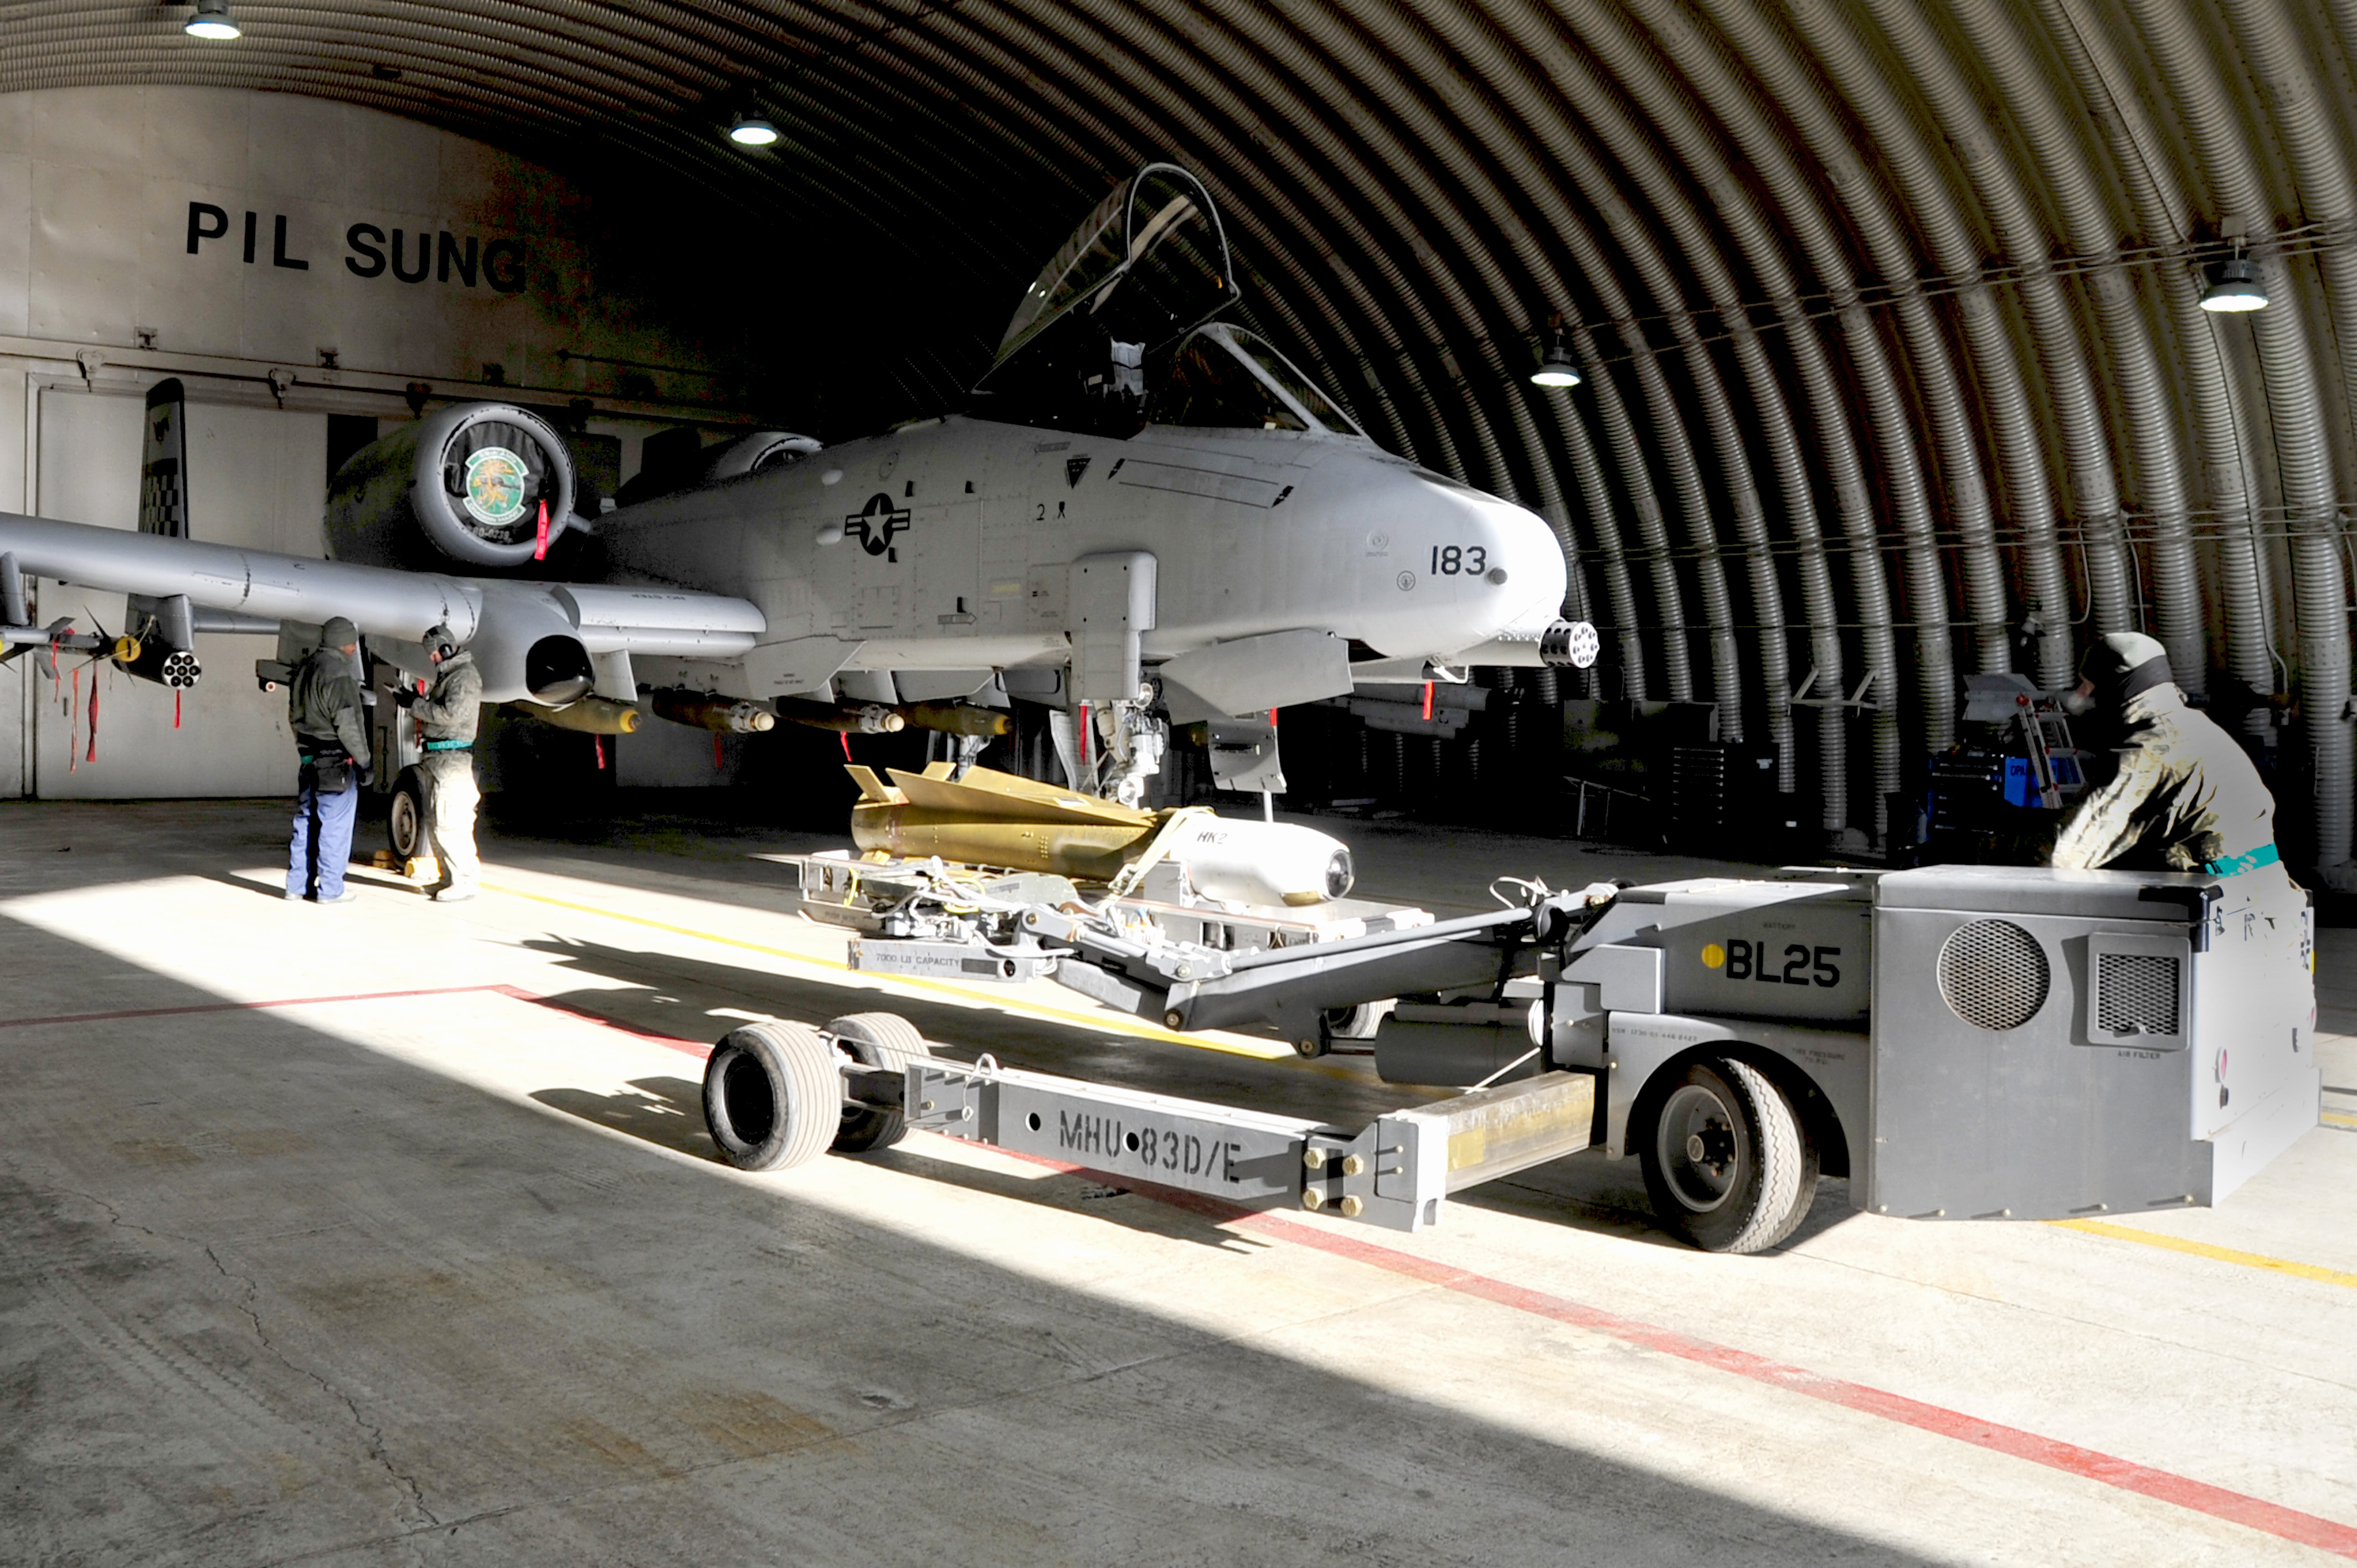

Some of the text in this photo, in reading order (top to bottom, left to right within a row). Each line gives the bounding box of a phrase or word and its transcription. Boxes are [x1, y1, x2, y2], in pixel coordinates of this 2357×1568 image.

[187, 202, 527, 293] PIL SUNG
[1431, 545, 1486, 575] 183
[877, 953, 897, 963] 7000
[915, 956, 960, 967] CAPACITY
[1726, 939, 1840, 988] BL25
